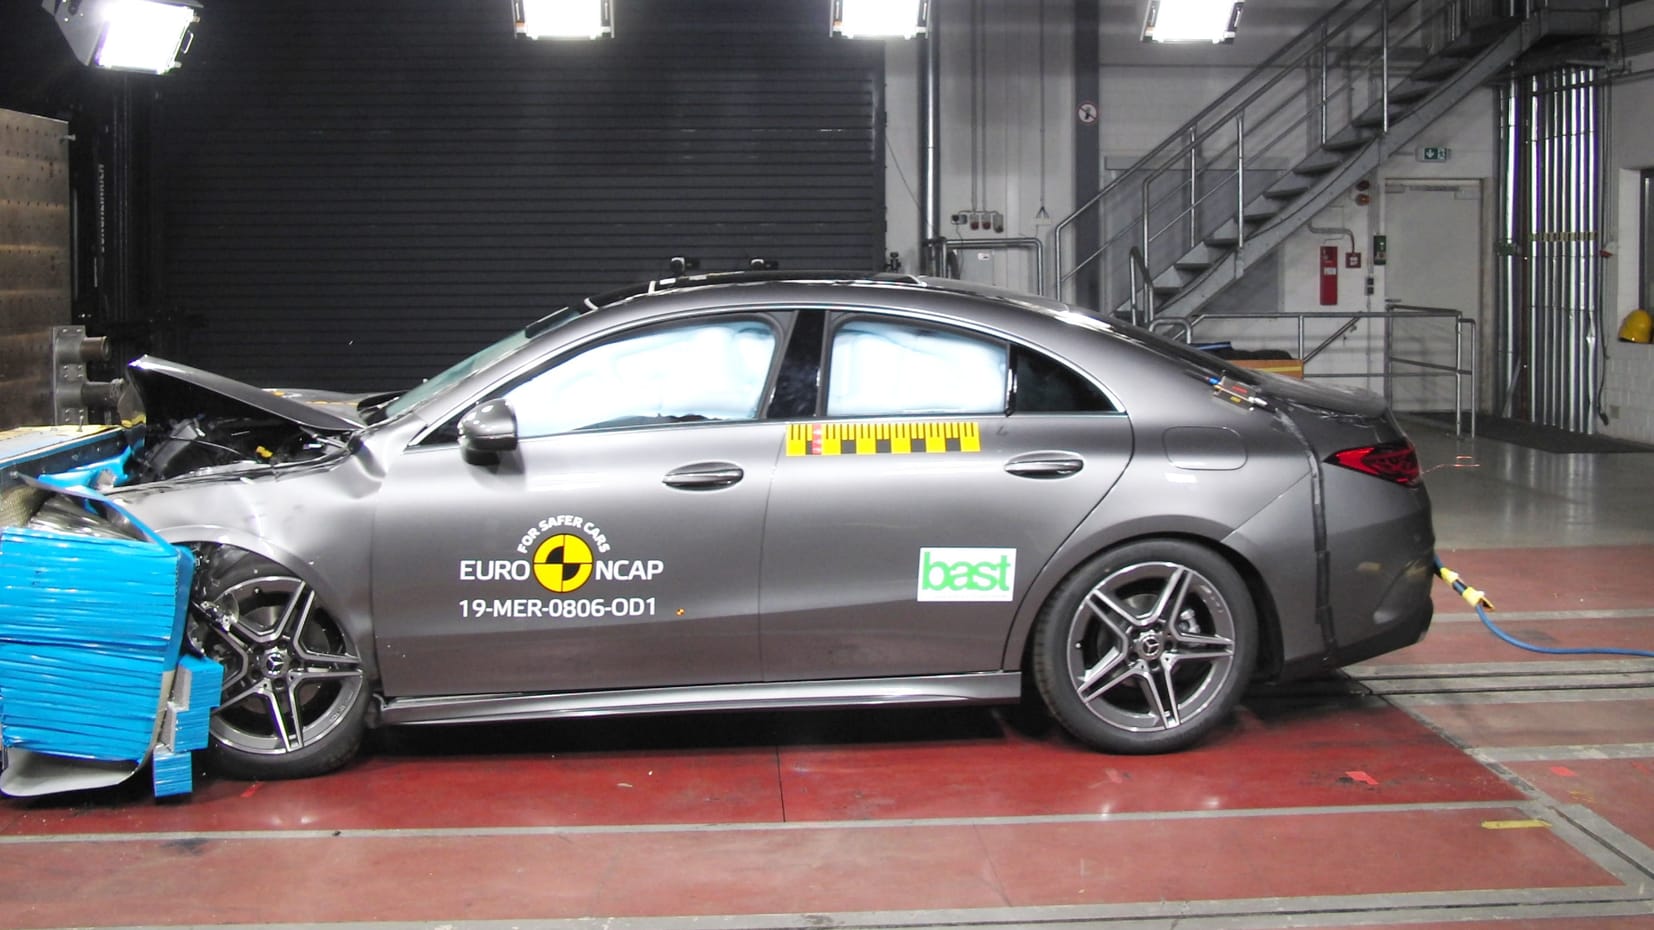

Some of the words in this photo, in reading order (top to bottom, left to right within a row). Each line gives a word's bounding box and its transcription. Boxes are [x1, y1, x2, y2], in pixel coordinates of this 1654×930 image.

[517, 527, 540, 554] FOR
[539, 515, 582, 532] SAFER
[583, 522, 611, 553] CARS
[459, 560, 531, 581] EURO
[595, 560, 664, 581] NCAP
[922, 551, 1011, 591] bast
[459, 597, 656, 618] 19-MER-0806-OD1
